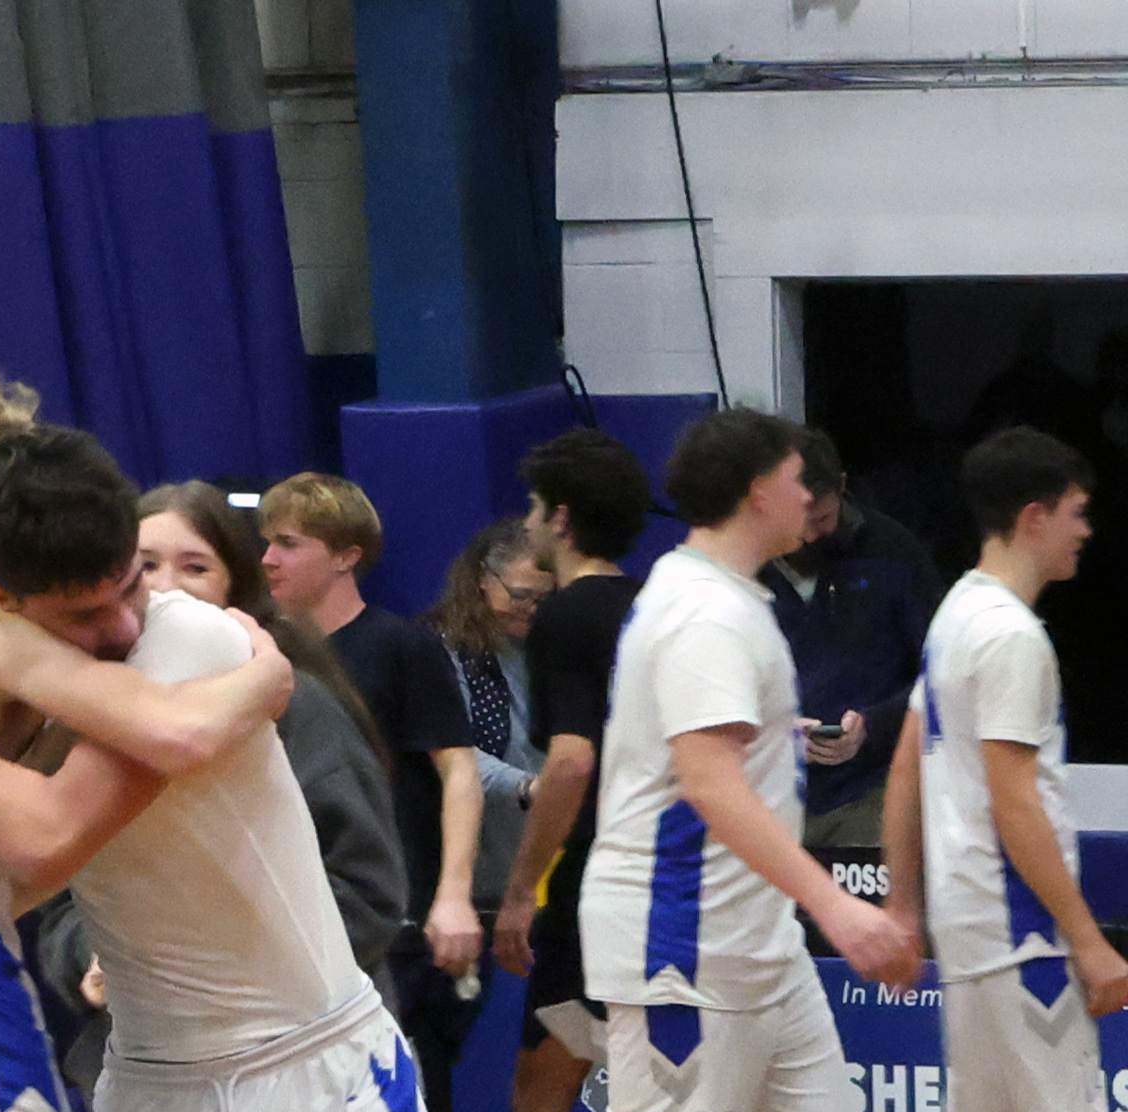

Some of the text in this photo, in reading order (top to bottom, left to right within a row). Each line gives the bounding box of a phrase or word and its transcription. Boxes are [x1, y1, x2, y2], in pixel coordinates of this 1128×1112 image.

[832, 862, 891, 896] POSS
[842, 979, 943, 1006] In Mem
